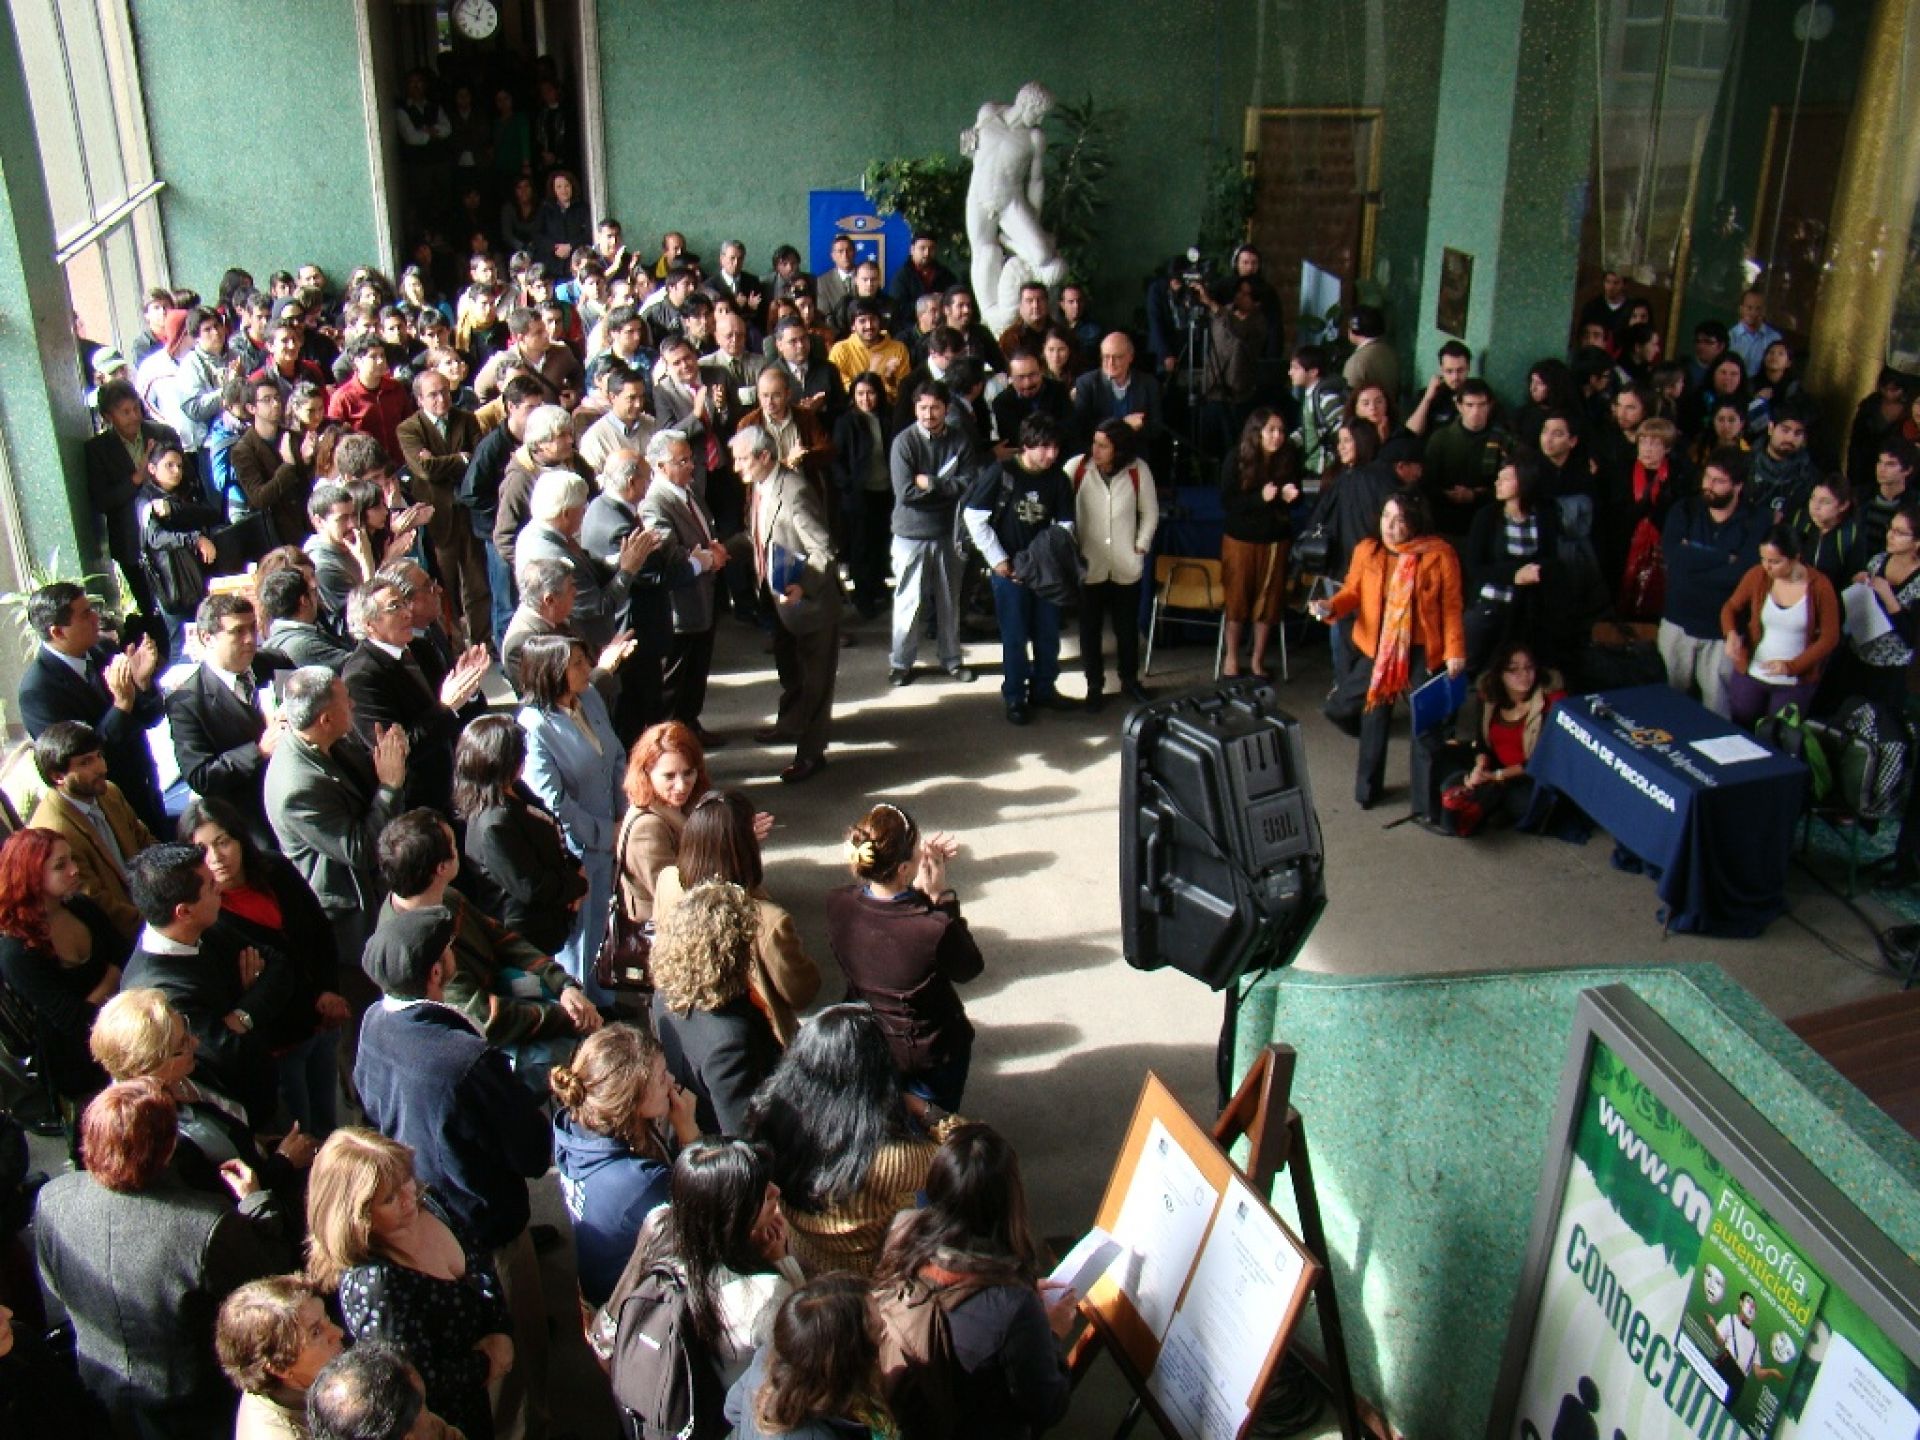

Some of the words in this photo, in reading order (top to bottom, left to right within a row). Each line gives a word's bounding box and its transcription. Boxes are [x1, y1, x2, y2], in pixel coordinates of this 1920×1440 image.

[1556, 710, 1599, 755] ESCUELA
[1598, 745, 1615, 766] DE
[1263, 812, 1298, 844] JBL
[1712, 1218, 1811, 1326] autenticidad
[1718, 1188, 1807, 1297] Filosofía
